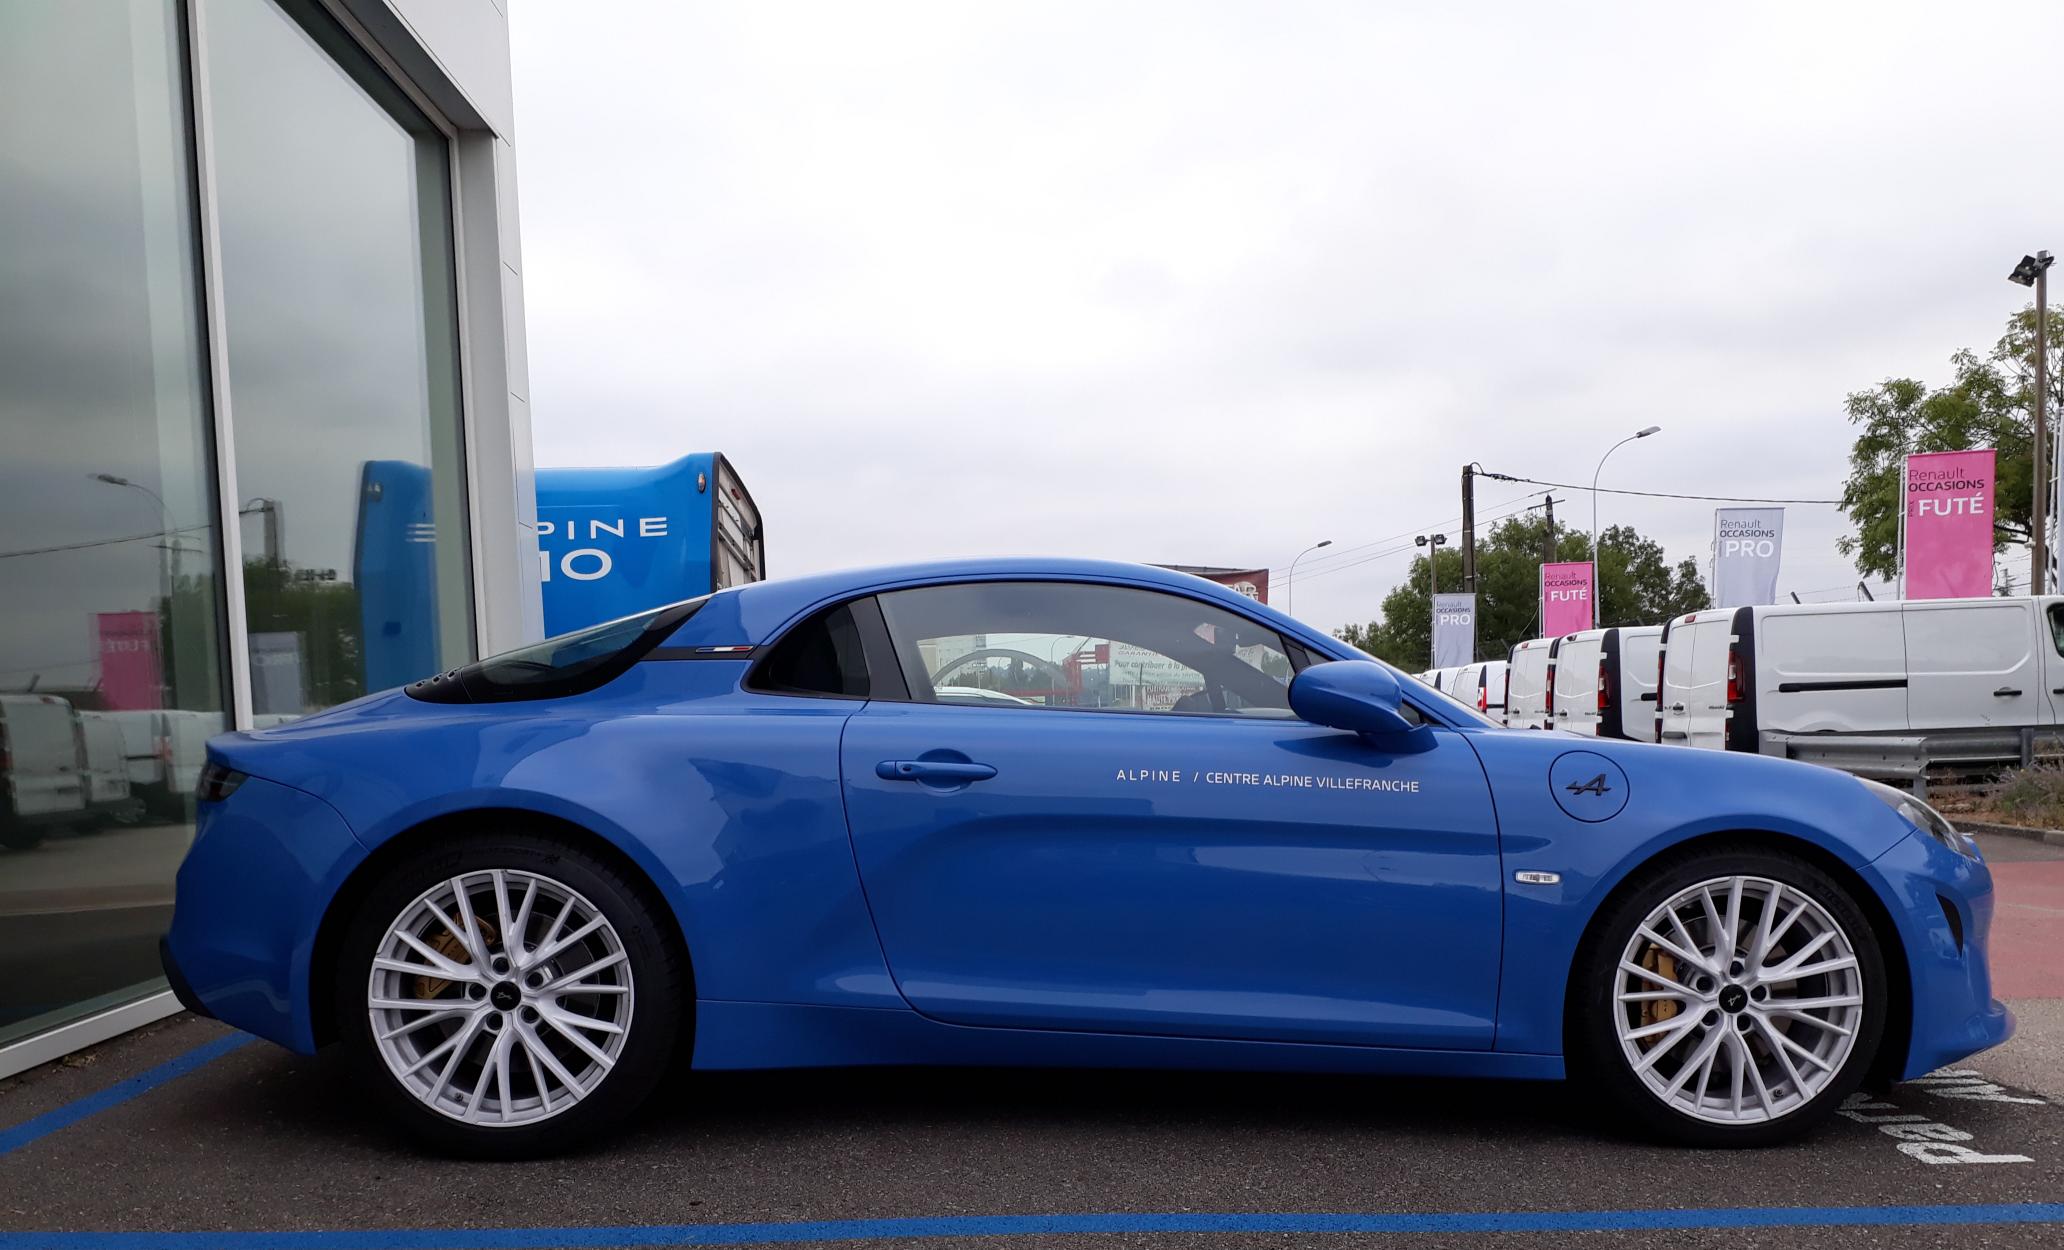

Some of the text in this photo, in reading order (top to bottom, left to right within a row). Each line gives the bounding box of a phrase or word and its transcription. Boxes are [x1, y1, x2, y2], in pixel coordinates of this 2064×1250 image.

[1909, 467, 1965, 480] Renault
[1909, 480, 1985, 492] OCCASIONS
[1919, 492, 1984, 516] FUTÉ
[1721, 519, 1761, 529] Renault
[1720, 529, 1775, 538] OCCASIONS
[1725, 540, 1774, 557] PRO
[1544, 572, 1576, 581] Renault
[1545, 579, 1588, 587] OCCASIONS
[1551, 587, 1588, 602] FUTÉ
[1440, 614, 1471, 625] PRO
[1117, 770, 1180, 781] ALPINE
[1206, 772, 1260, 785] CENTRE
[1264, 775, 1312, 787] ALPINE
[1317, 777, 1419, 792] VILLEFRANCHE
